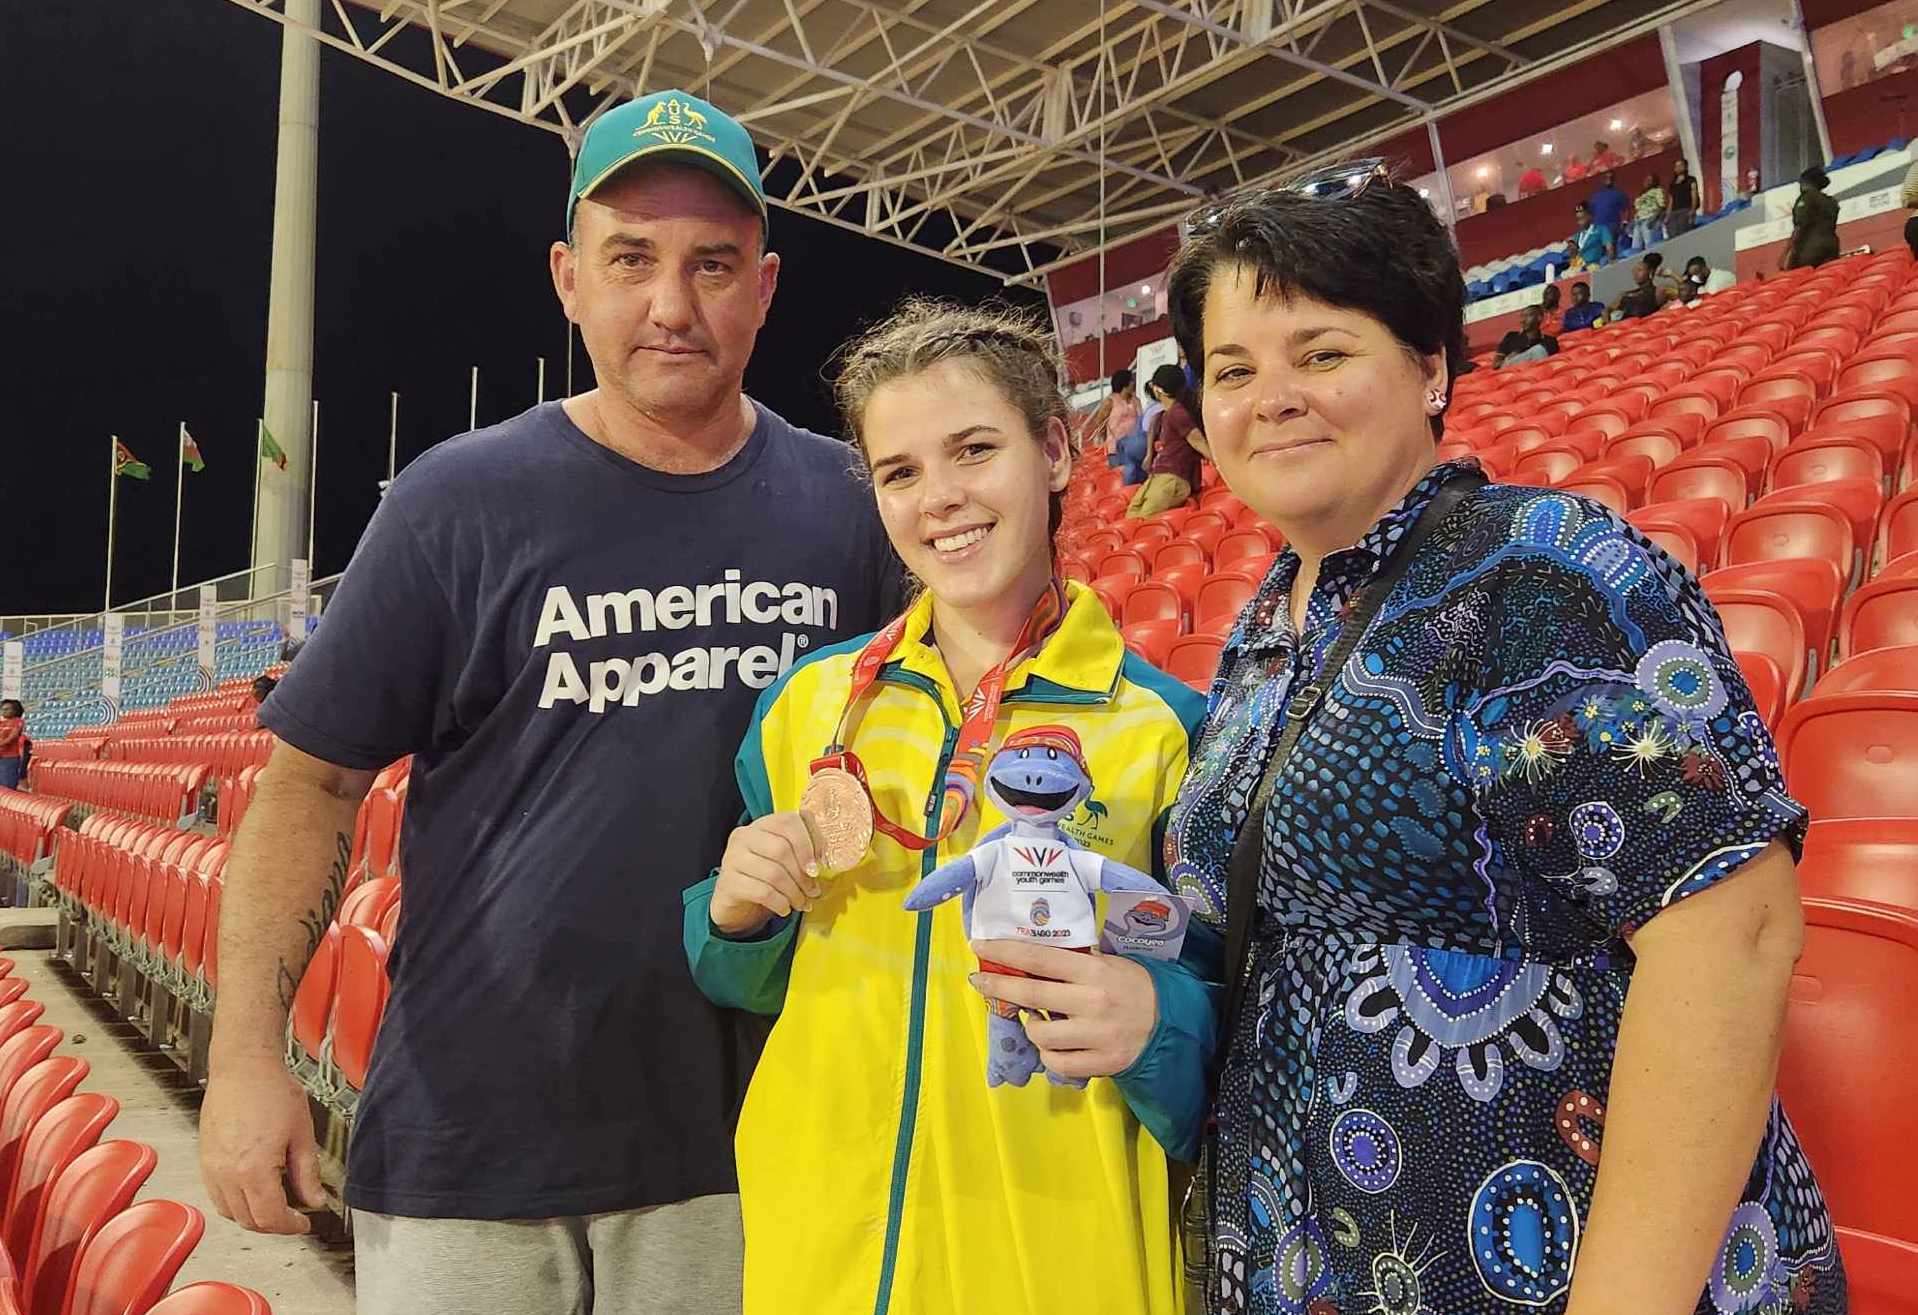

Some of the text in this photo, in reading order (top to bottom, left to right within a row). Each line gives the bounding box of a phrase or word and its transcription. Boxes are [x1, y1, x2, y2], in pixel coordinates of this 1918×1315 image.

[533, 568, 838, 648] American
[1087, 831, 1115, 846] GAMES
[1011, 870, 1069, 878] commonwealth
[1015, 876, 1065, 885] youth games
